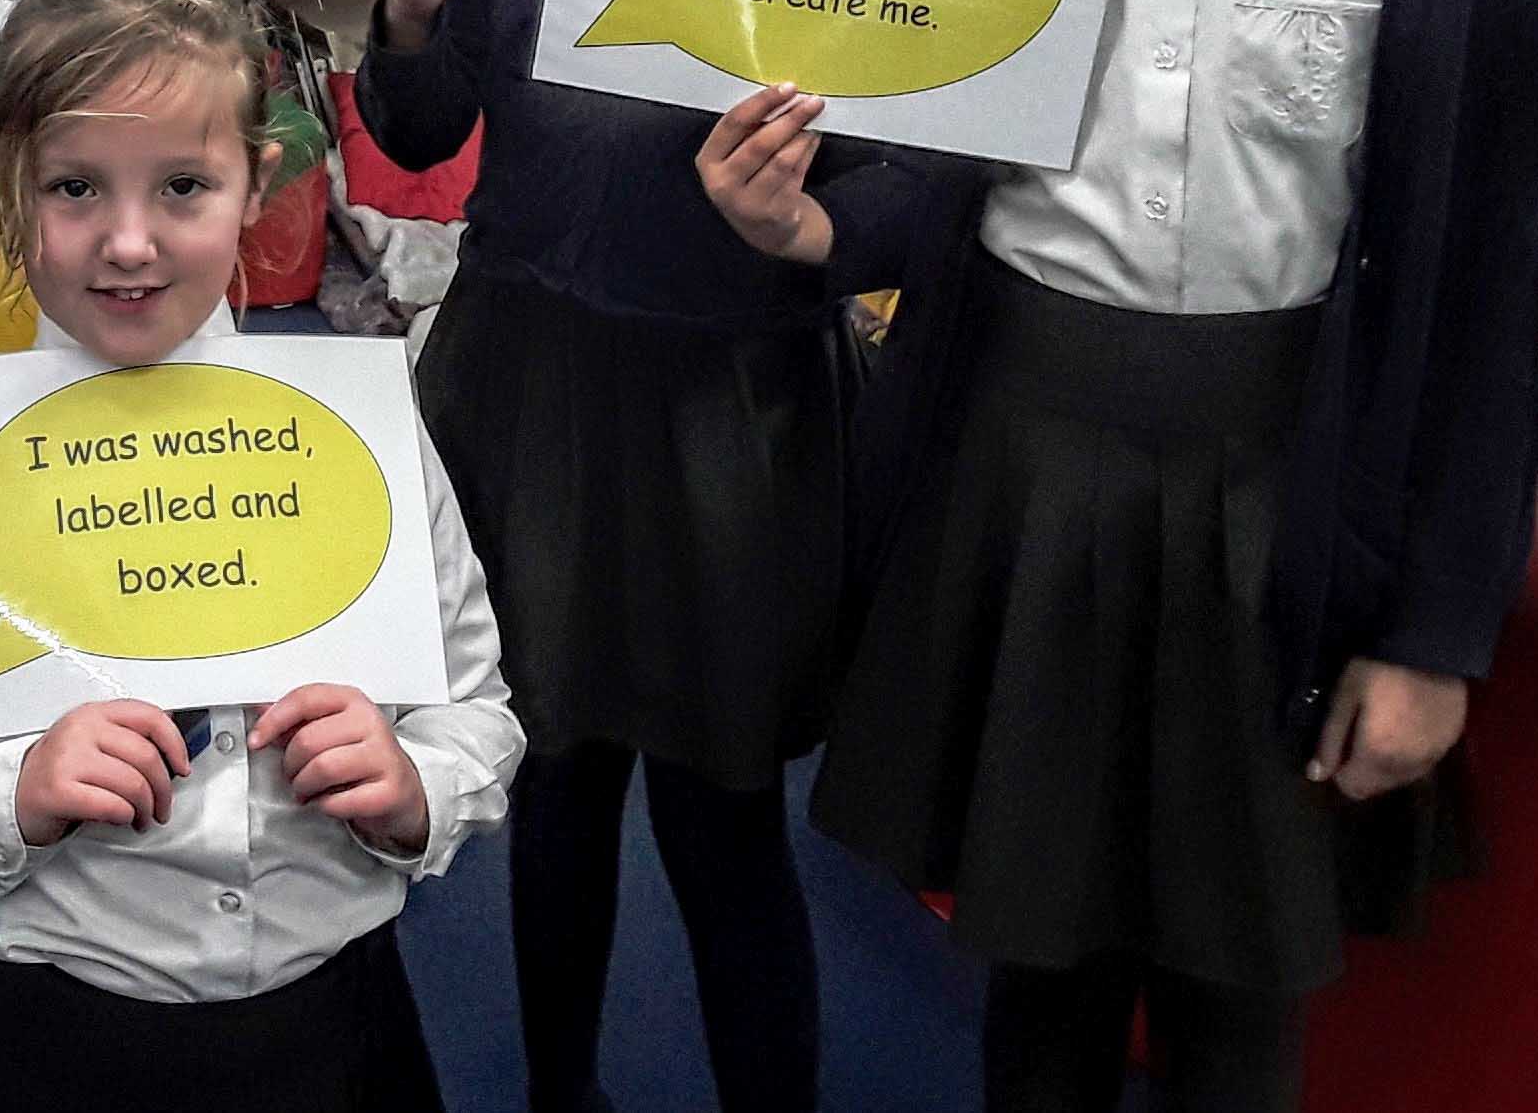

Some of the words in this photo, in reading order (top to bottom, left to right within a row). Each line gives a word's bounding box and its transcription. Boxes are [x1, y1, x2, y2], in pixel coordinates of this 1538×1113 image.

[878, 0, 940, 31] me.
[24, 436, 51, 472] I
[63, 431, 140, 466] was
[152, 416, 314, 462] washed,
[55, 483, 217, 536] labelled
[230, 480, 301, 521] and
[118, 548, 259, 597] boxed.
